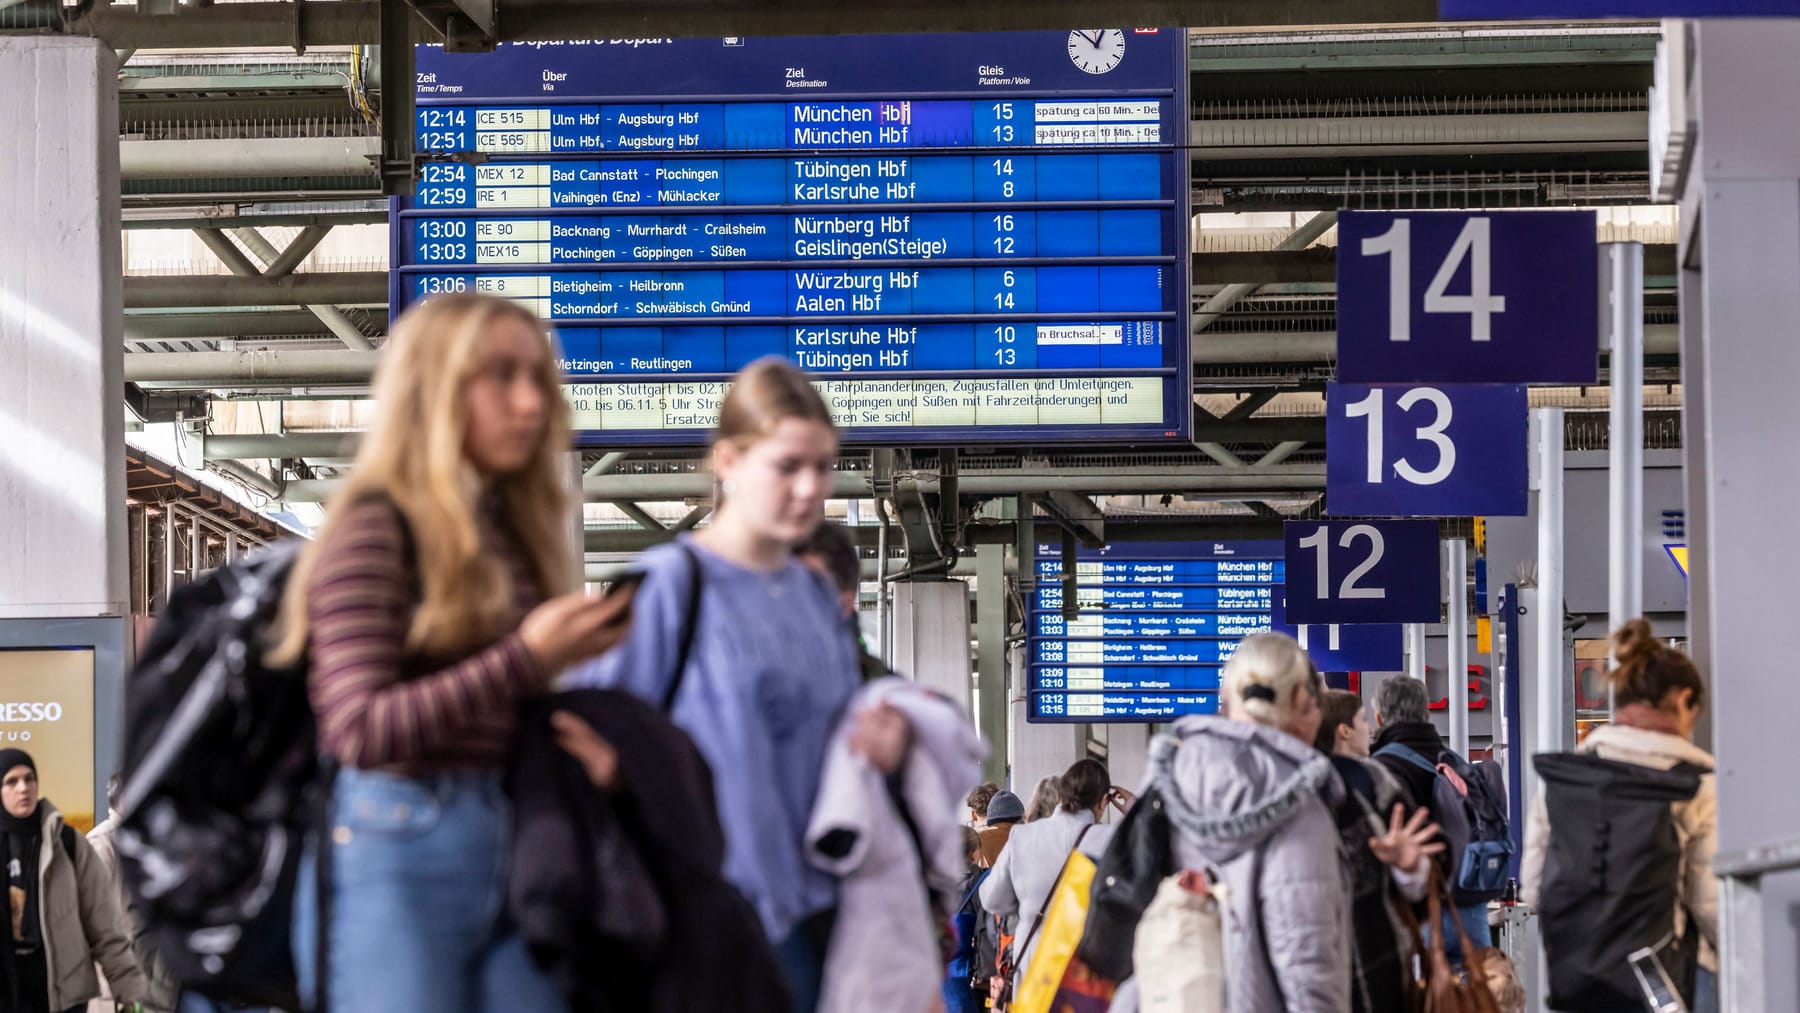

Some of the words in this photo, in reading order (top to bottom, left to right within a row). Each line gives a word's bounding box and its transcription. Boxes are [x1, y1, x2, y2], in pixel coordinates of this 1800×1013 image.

[416, 72, 436, 83] Zeit
[542, 69, 568, 82] Über
[786, 68, 804, 78] Ziel
[978, 66, 1004, 76] Gleis
[416, 84, 463, 93] Time/Temps
[543, 83, 554, 91] Via
[786, 80, 828, 88] Destination
[979, 77, 1030, 86] Platform/Voie
[420, 110, 466, 127] 12:14
[478, 112, 496, 124] ICE
[500, 112, 524, 124] 515
[794, 105, 872, 122] München
[992, 104, 1014, 120] 15
[1083, 107, 1096, 116] ca
[1098, 106, 1110, 115] 60
[1113, 106, 1134, 115] Min.
[552, 114, 575, 126] Ulm
[580, 114, 600, 126] Hbf
[618, 112, 674, 128] Augsburg
[678, 112, 700, 125] Hbf
[420, 132, 466, 149] 12:51
[478, 134, 496, 146] ICE
[500, 134, 524, 146] 565
[794, 127, 872, 144] München
[879, 126, 908, 144] Hbf
[992, 126, 1014, 142] 13
[1083, 130, 1096, 138] ca
[1114, 128, 1134, 138] Min.
[552, 136, 575, 148] Ulm
[580, 136, 600, 148] Hbf
[618, 134, 674, 149] Augsburg
[678, 134, 700, 146] Hbf
[420, 166, 466, 183] 12:54
[478, 168, 504, 180] MEX
[510, 168, 524, 180] 12
[552, 170, 575, 181] Bad
[580, 168, 638, 181] Cannstatt
[656, 168, 718, 182] Plochingen
[794, 161, 871, 181] Tübingen
[878, 160, 907, 177] Hbf
[993, 160, 1015, 176] 14
[420, 188, 466, 205] 12:59
[478, 191, 494, 202] IRE
[500, 190, 508, 202] 1
[552, 192, 608, 206] Vaihingen
[612, 191, 640, 203] (Enz)
[658, 190, 720, 202] Mühlacker
[794, 184, 880, 200] Karlsruhe
[886, 182, 916, 199] Hbf
[1003, 182, 1014, 198] 8
[420, 222, 466, 238] 13:00
[478, 224, 492, 235] RE
[498, 224, 513, 234] 90
[552, 225, 610, 239] Backnang
[628, 224, 687, 236] Murrhardt
[704, 223, 766, 235] Crailsheim
[794, 216, 874, 237] Nürnberg
[880, 216, 910, 233] Hbf
[993, 215, 1014, 232] 16
[420, 244, 466, 260] 13:03
[478, 246, 520, 257] MEX16
[552, 247, 616, 260] Plochingen
[633, 246, 693, 260] Göppingen
[710, 245, 746, 257] Süßen
[794, 238, 947, 260] Geislingen(Steige)
[993, 237, 1014, 254] 12
[420, 276, 466, 294] 13:06
[478, 280, 492, 291] RE
[498, 280, 505, 290] 8
[552, 280, 612, 294] Bietigheim
[630, 280, 684, 292] Heilbronn
[795, 272, 882, 292] Würzburg
[889, 272, 919, 289] Hbf
[1004, 270, 1014, 288] 6
[1361, 217, 1506, 342] 14
[553, 302, 618, 315] Schorndorf
[636, 301, 706, 314] Schwäbisch
[712, 300, 750, 313] Gmünd
[796, 295, 845, 312] Aalen
[852, 294, 881, 311] Hbf
[994, 292, 1015, 310] 14
[796, 328, 881, 345] Karlsruhe
[888, 328, 917, 344] Hbf
[994, 326, 1016, 343] 10
[796, 351, 872, 371] Tübingen
[880, 350, 909, 367] Hbf
[994, 348, 1016, 365] 13
[554, 358, 614, 372] Metzingen
[631, 358, 692, 372] Reutlingen
[572, 384, 613, 396] Knoten
[618, 384, 672, 398] Stuttgart
[677, 384, 694, 394] bis
[1034, 379, 1055, 391] und
[1060, 378, 1134, 392] Umleitungen.
[596, 400, 613, 410] bis
[618, 399, 654, 410] 06.11.
[659, 398, 667, 410] 5
[672, 398, 691, 410] Uhr
[697, 398, 722, 410] Stre
[832, 396, 892, 410] Göppingen
[897, 396, 918, 407] und
[962, 395, 981, 406] mit
[1108, 394, 1128, 404] und
[666, 414, 720, 424] Ersatzve
[862, 412, 880, 422] Sie
[884, 411, 910, 422] sich!
[1346, 387, 1456, 486] 13
[1218, 562, 1256, 572] München
[1258, 562, 1272, 572] Hbf
[1299, 526, 1386, 599] 12
[1218, 588, 1255, 600] Tübingen
[1218, 615, 1256, 626] Nürnberg
[1218, 642, 1244, 651] Würz
